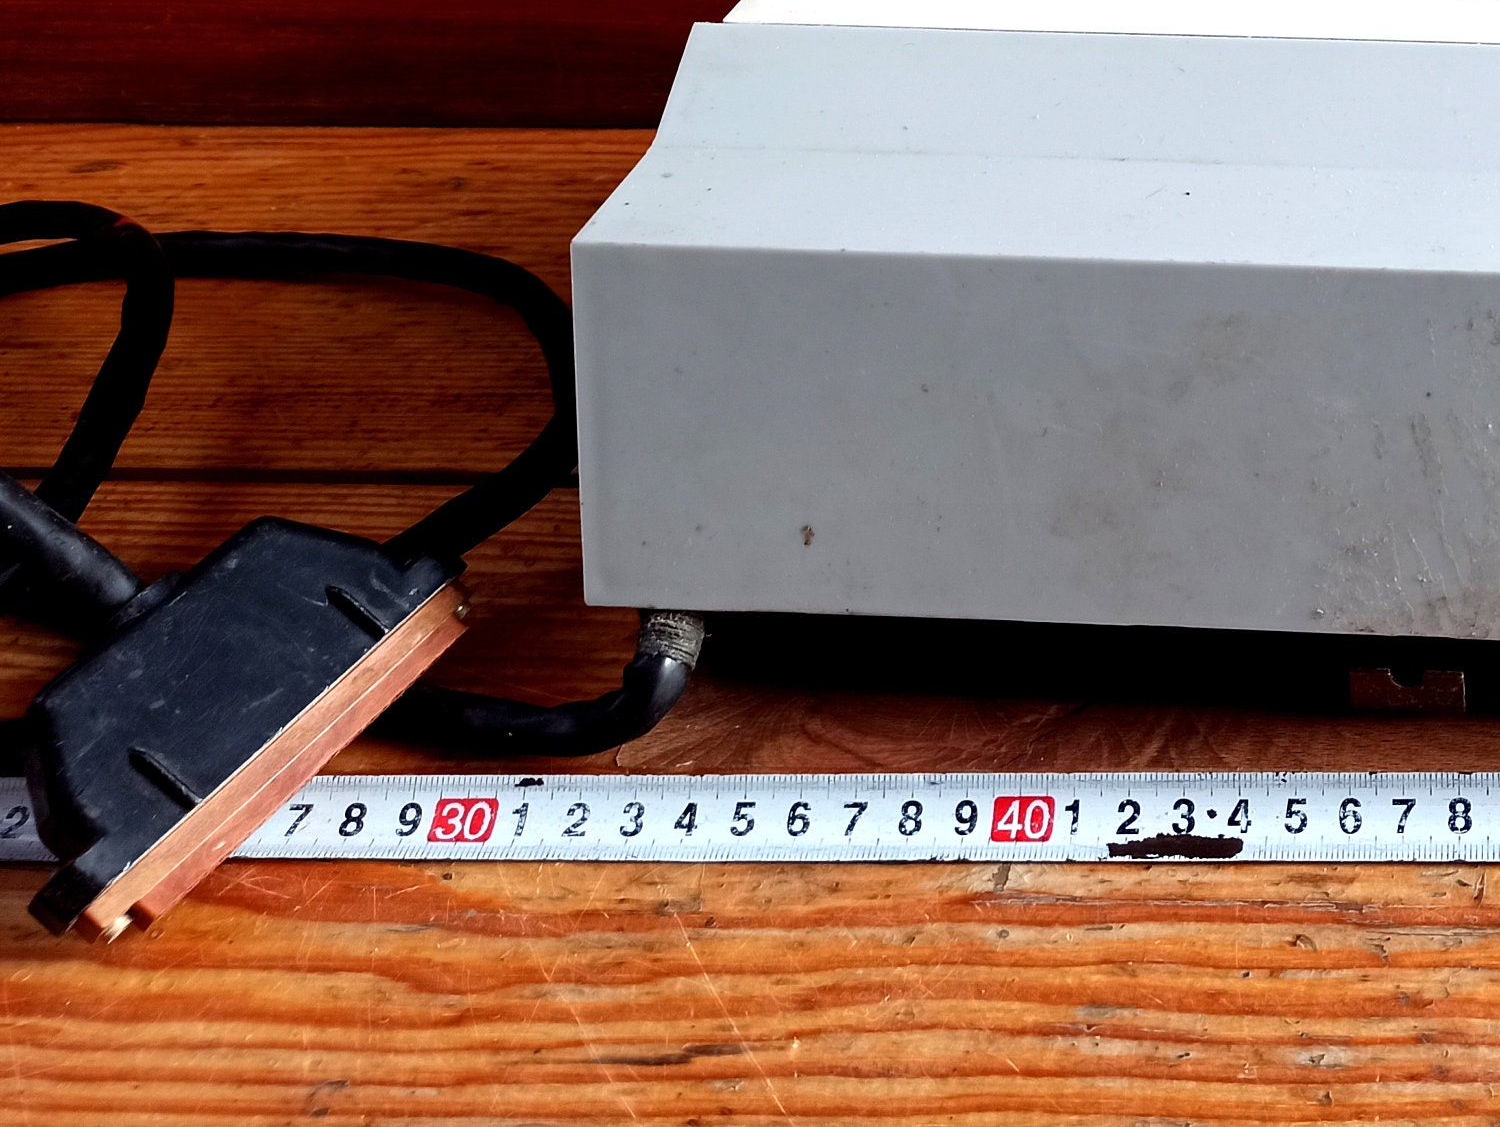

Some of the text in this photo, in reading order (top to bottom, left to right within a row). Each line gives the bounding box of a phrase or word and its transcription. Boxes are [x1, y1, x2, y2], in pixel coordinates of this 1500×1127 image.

[0, 805, 30, 839] 2
[285, 804, 313, 836] 7
[339, 803, 366, 836] 8
[399, 803, 422, 836] 9
[434, 802, 491, 840] 30
[512, 803, 529, 837] 1
[563, 803, 590, 837] 2
[618, 802, 645, 837] 3
[674, 802, 699, 836] 4
[731, 802, 755, 836] 5
[787, 802, 810, 836] 6
[843, 801, 869, 836] 7
[899, 801, 922, 835] 8
[955, 800, 977, 835] 9
[997, 799, 1051, 838] 40
[1065, 800, 1079, 834] 1
[1116, 800, 1140, 834] 2
[1172, 798, 1196, 834] 3
[1228, 800, 1251, 833] 4
[1285, 799, 1307, 833] 5
[1339, 798, 1361, 834] 6
[1393, 799, 1415, 833] 7
[1448, 798, 1472, 833] 8
